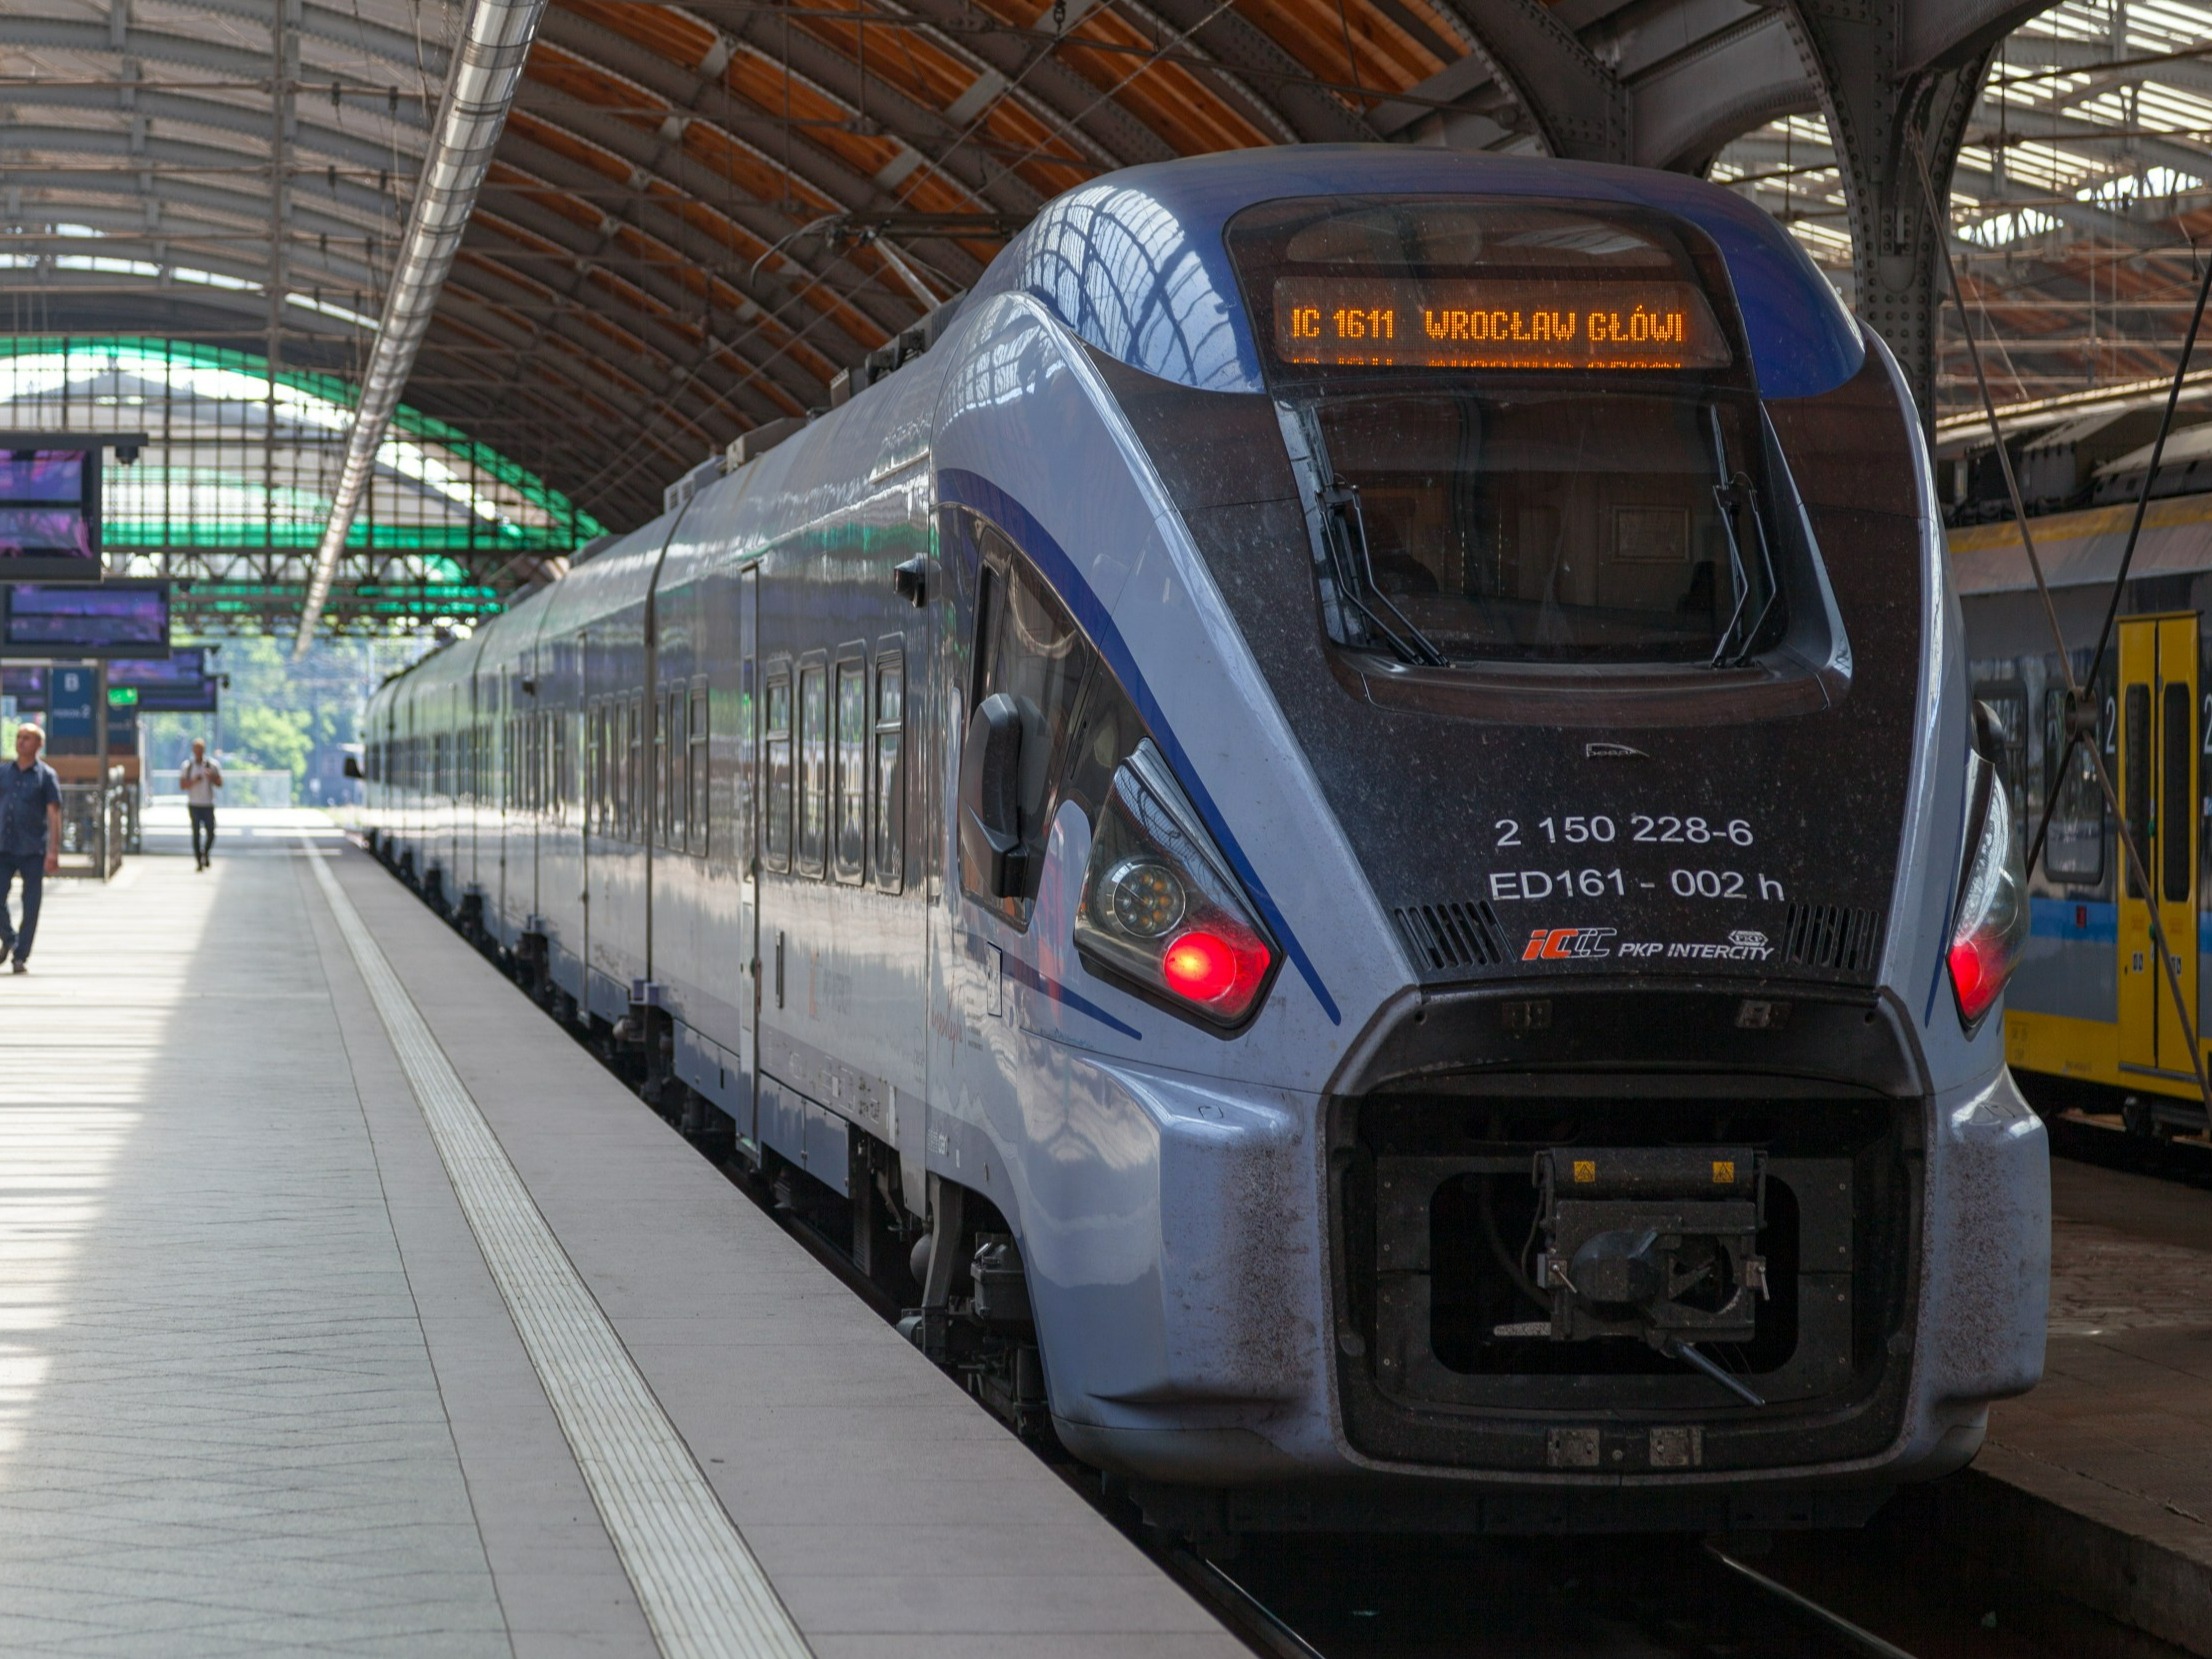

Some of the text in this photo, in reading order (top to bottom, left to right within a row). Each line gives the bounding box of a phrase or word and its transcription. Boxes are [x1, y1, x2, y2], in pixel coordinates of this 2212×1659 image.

[1292, 309, 1320, 338] IC
[1333, 309, 1394, 339] 1611
[1425, 310, 1575, 342] WROCŁAW
[2105, 696, 2116, 754] 2
[1495, 815, 1754, 846] 2 150 228-6
[1489, 869, 1626, 901] ED161
[1671, 870, 1748, 898] 002
[1759, 873, 1785, 901] h
[1618, 942, 1664, 958] PKP
[1667, 943, 1775, 961] INTERCITY
